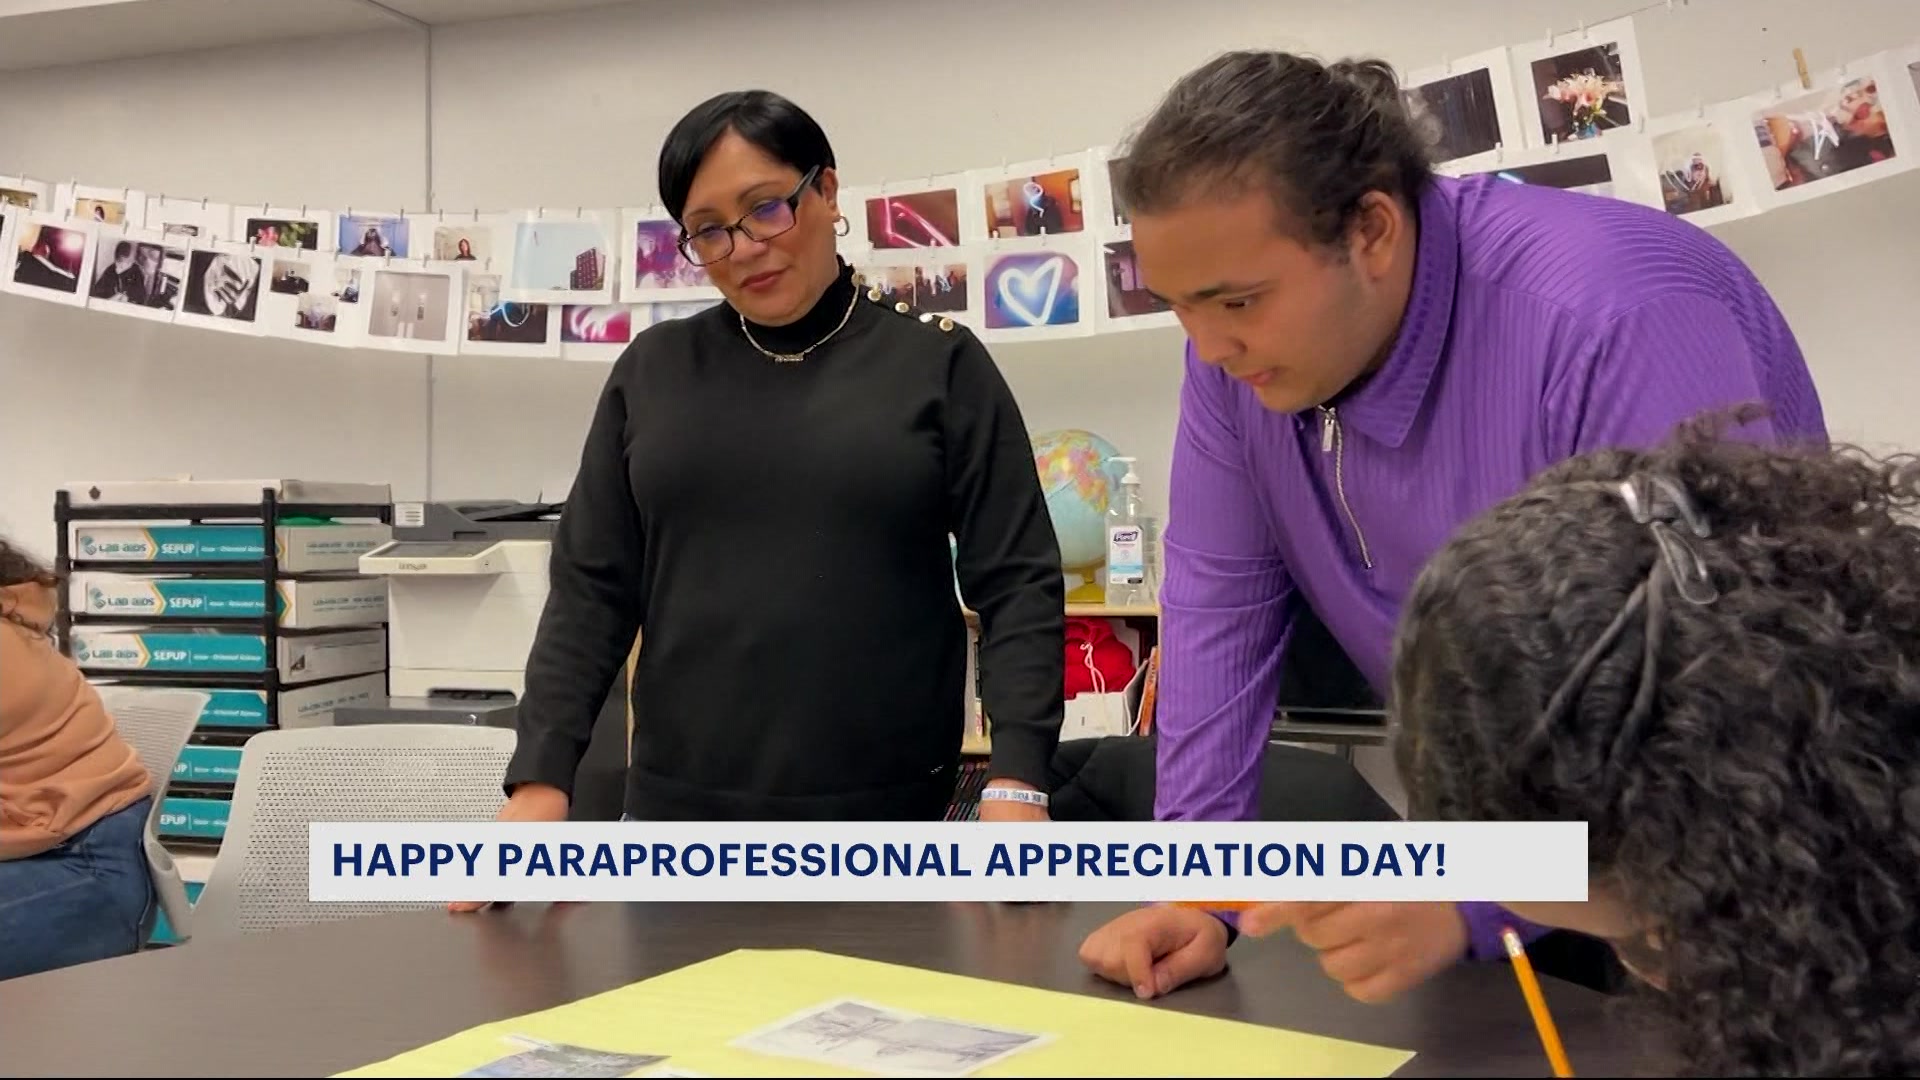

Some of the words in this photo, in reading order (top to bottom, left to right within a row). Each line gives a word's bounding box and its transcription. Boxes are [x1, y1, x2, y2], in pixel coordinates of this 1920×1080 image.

[161, 543, 195, 554] SEPUP
[169, 597, 203, 608] SEPUP
[153, 650, 187, 661] SEPUP
[160, 814, 187, 825] EPUP
